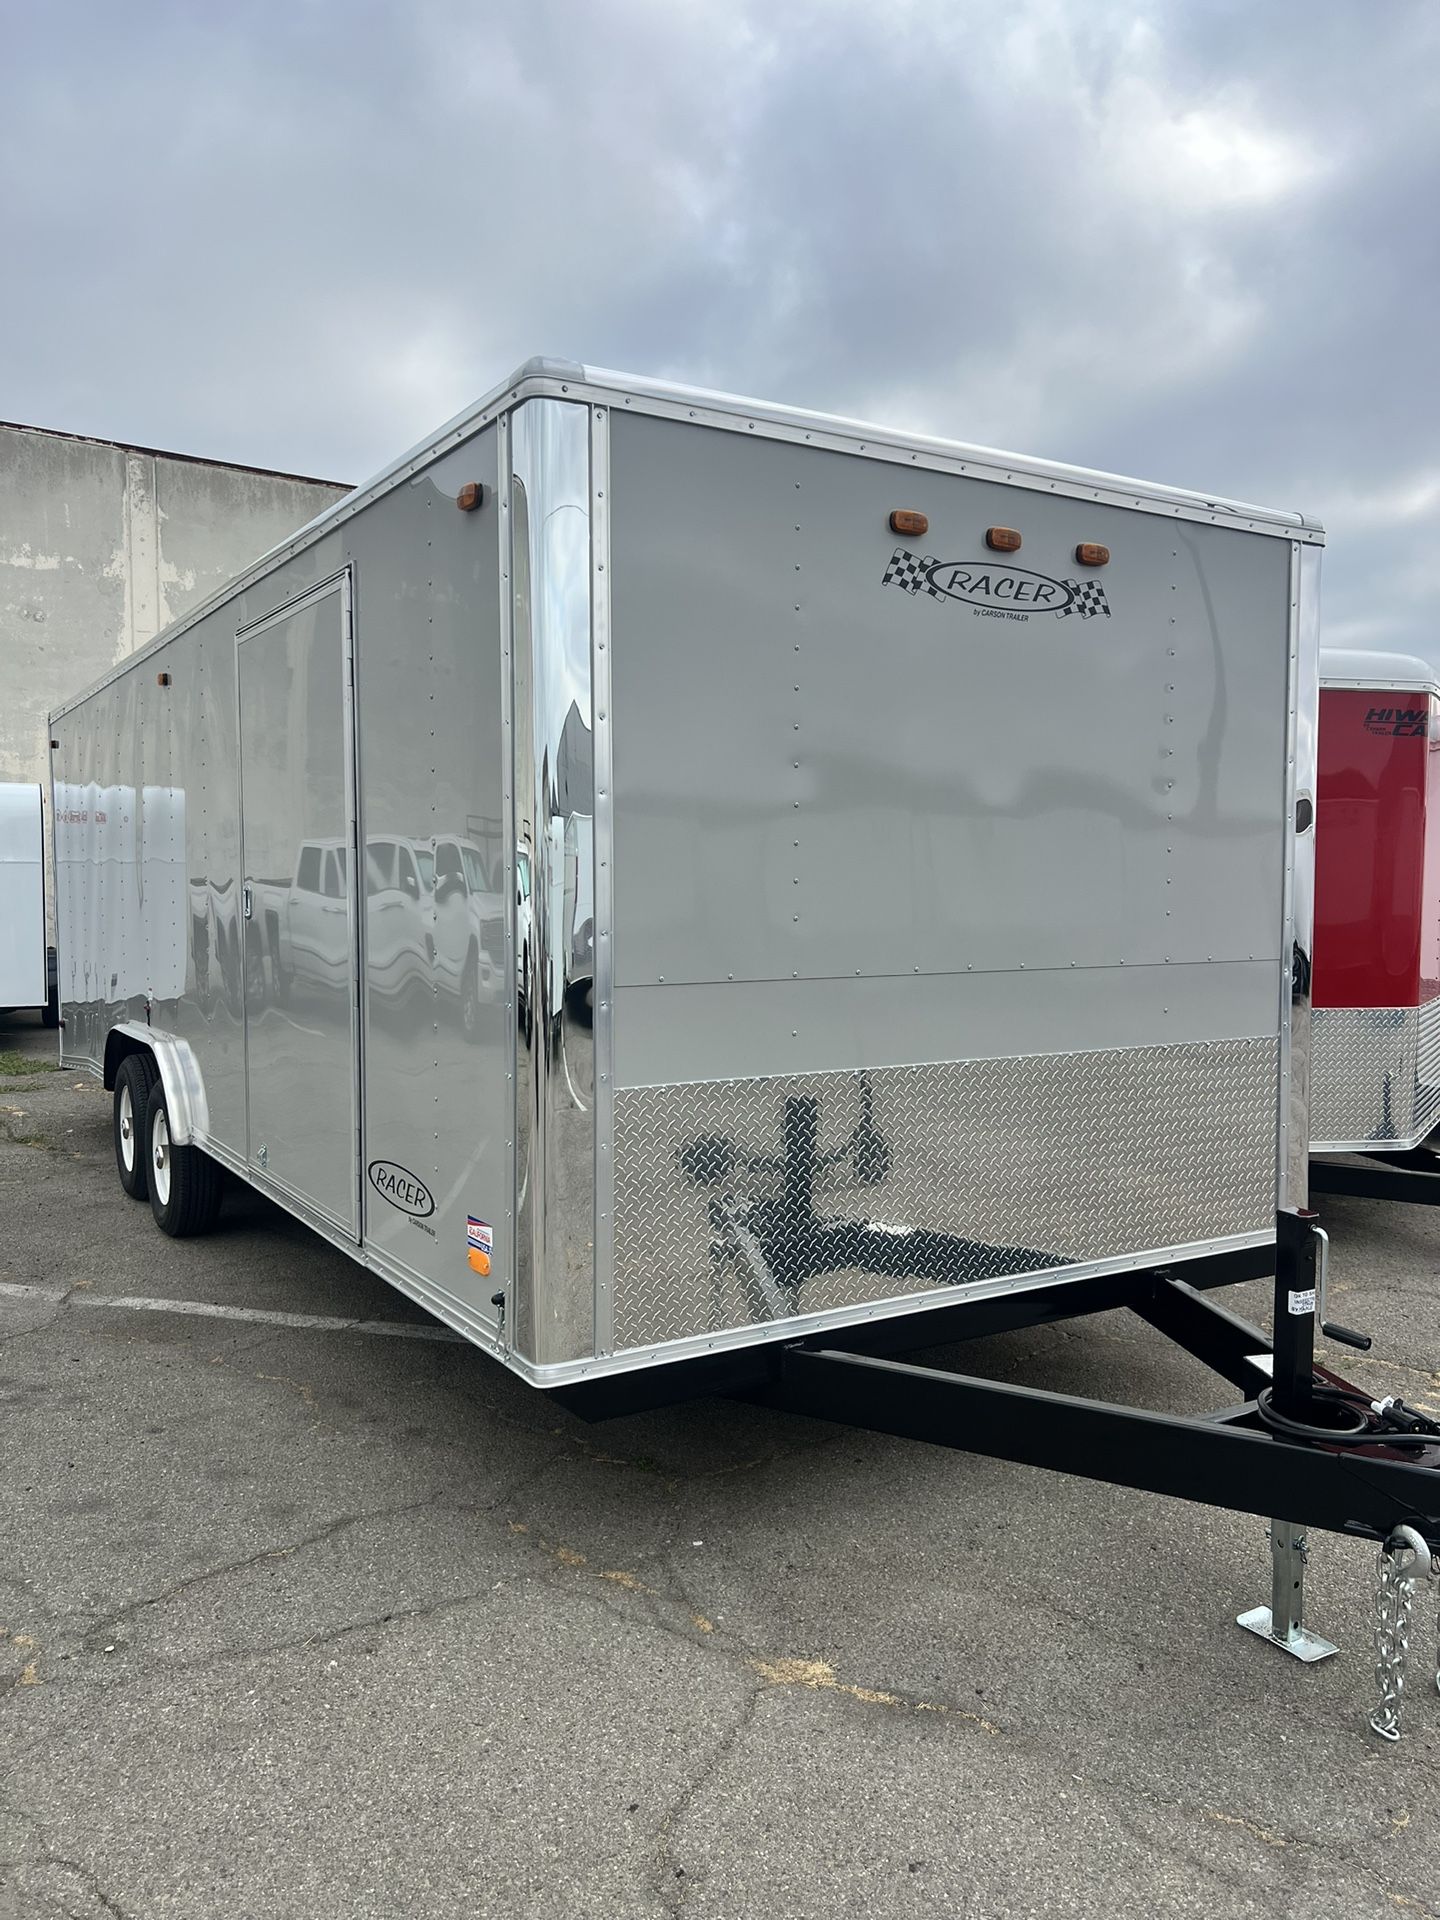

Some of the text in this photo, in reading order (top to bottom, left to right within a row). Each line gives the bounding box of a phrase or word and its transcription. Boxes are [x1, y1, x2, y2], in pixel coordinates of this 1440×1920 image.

[947, 570, 1056, 603] RACER
[973, 608, 1029, 622] by CARSON TRAILER
[376, 1167, 426, 1209] RACER
